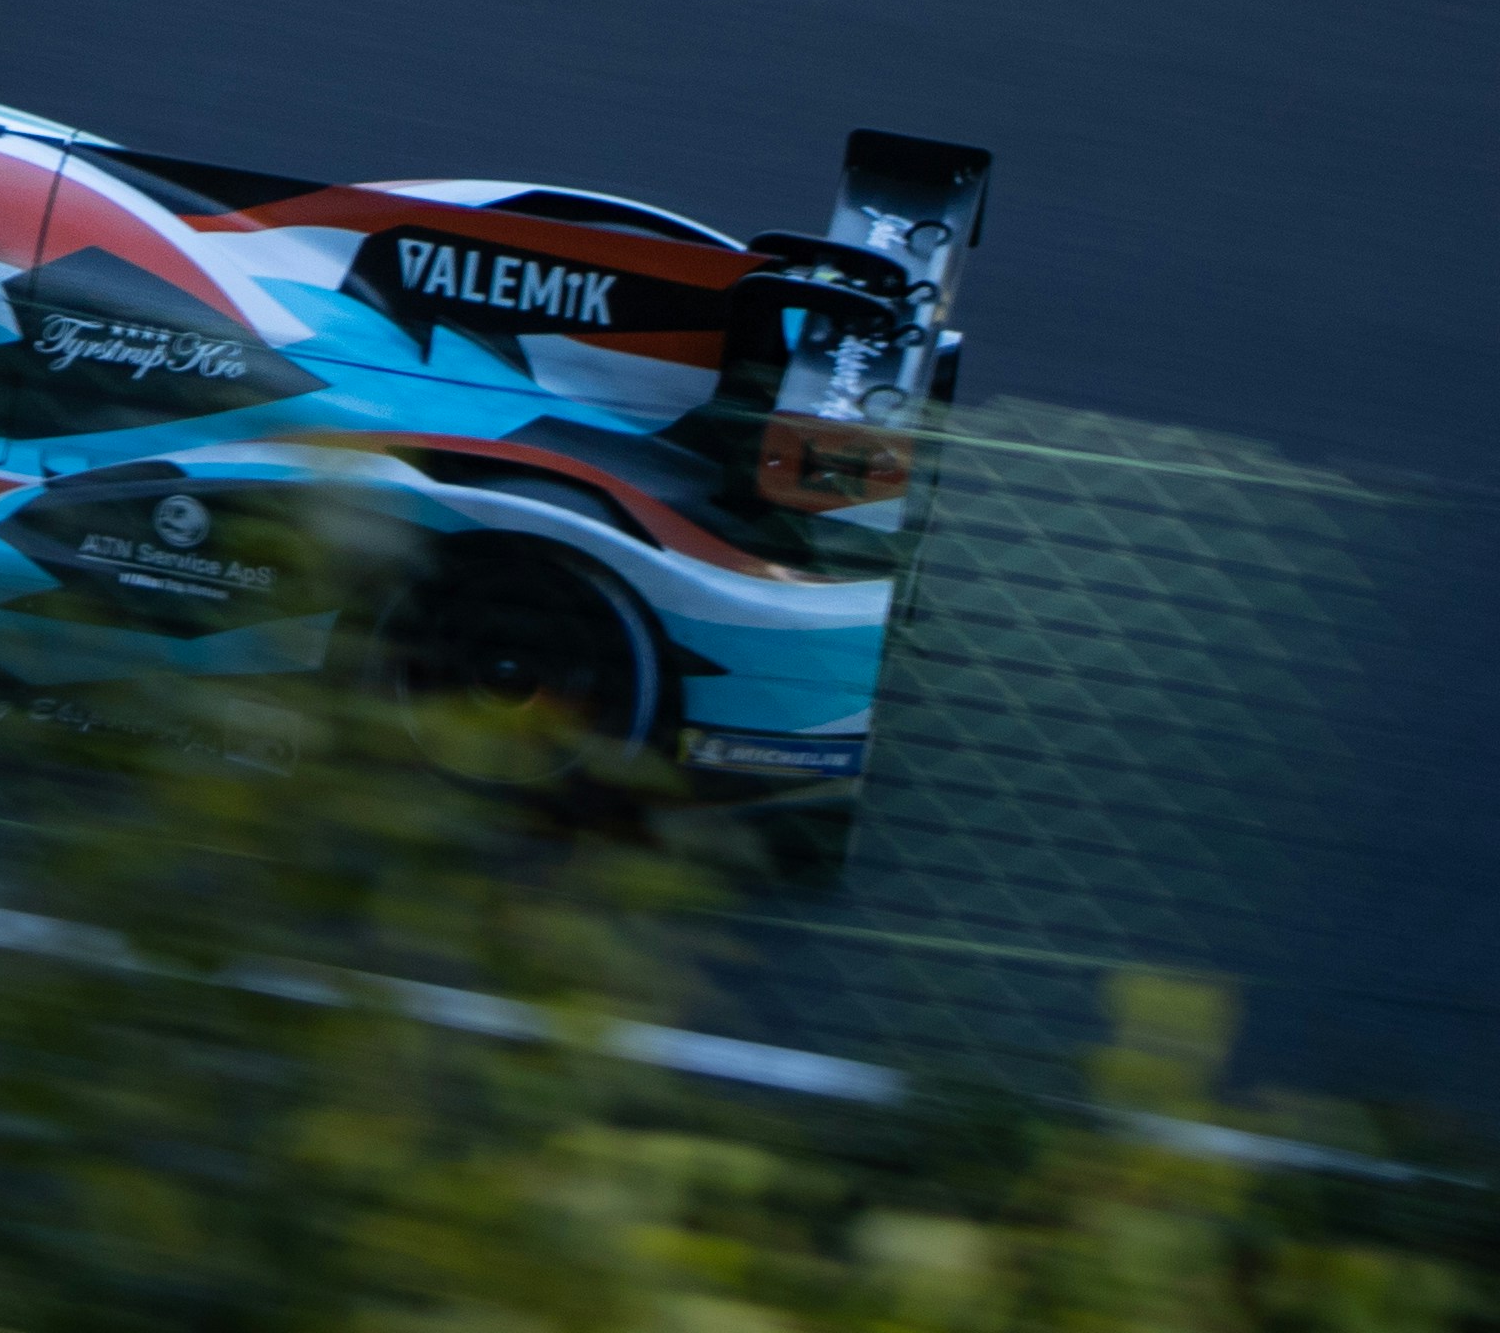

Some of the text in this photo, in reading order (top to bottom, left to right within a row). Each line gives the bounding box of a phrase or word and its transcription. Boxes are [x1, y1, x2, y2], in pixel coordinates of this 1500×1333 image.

[398, 237, 618, 326] VALEMIK
[164, 332, 248, 378] Kro
[136, 542, 222, 576] Service
